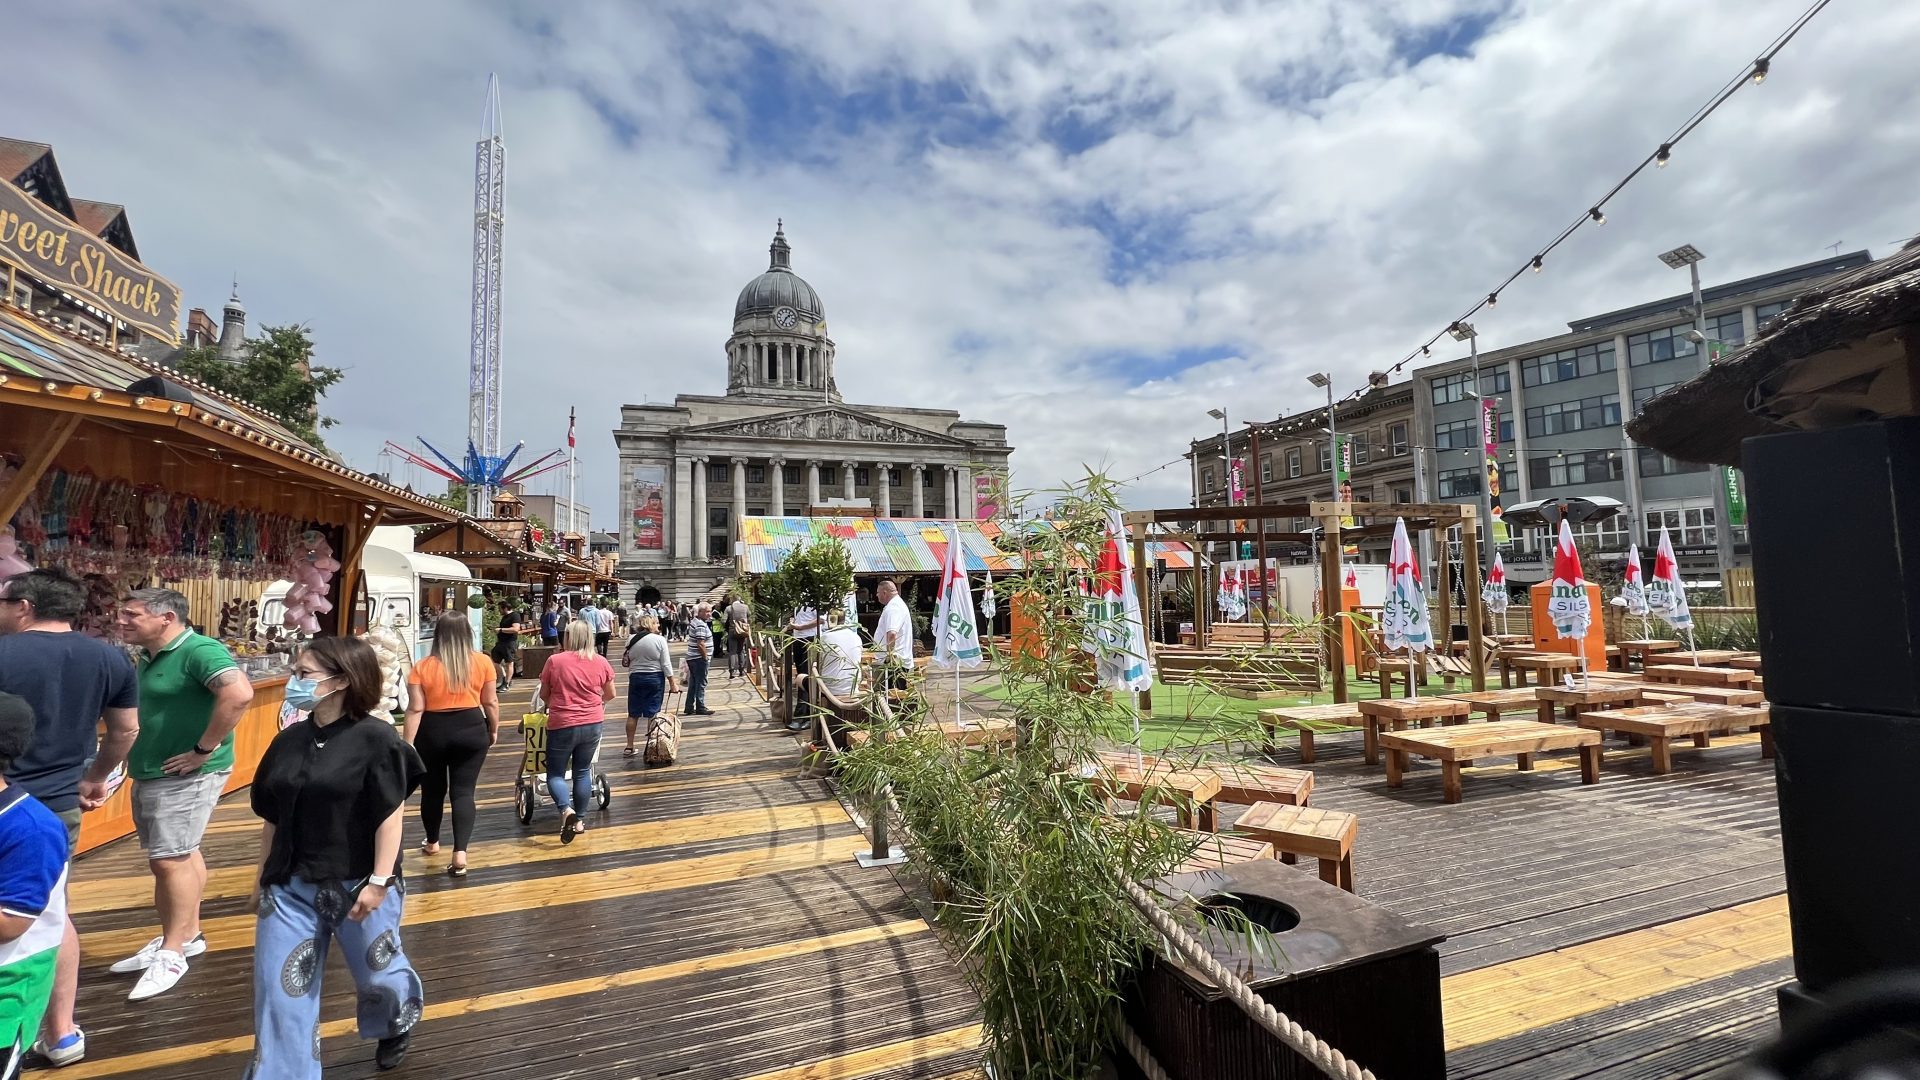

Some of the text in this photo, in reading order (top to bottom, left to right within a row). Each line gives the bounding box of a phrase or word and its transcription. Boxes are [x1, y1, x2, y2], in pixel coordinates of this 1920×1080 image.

[70, 243, 160, 316] Shack
[1337, 441, 1345, 473] EVERY
[1232, 465, 1240, 491] EVERY
[1514, 555, 1537, 563] JOSEPH
[525, 727, 548, 749] RI
